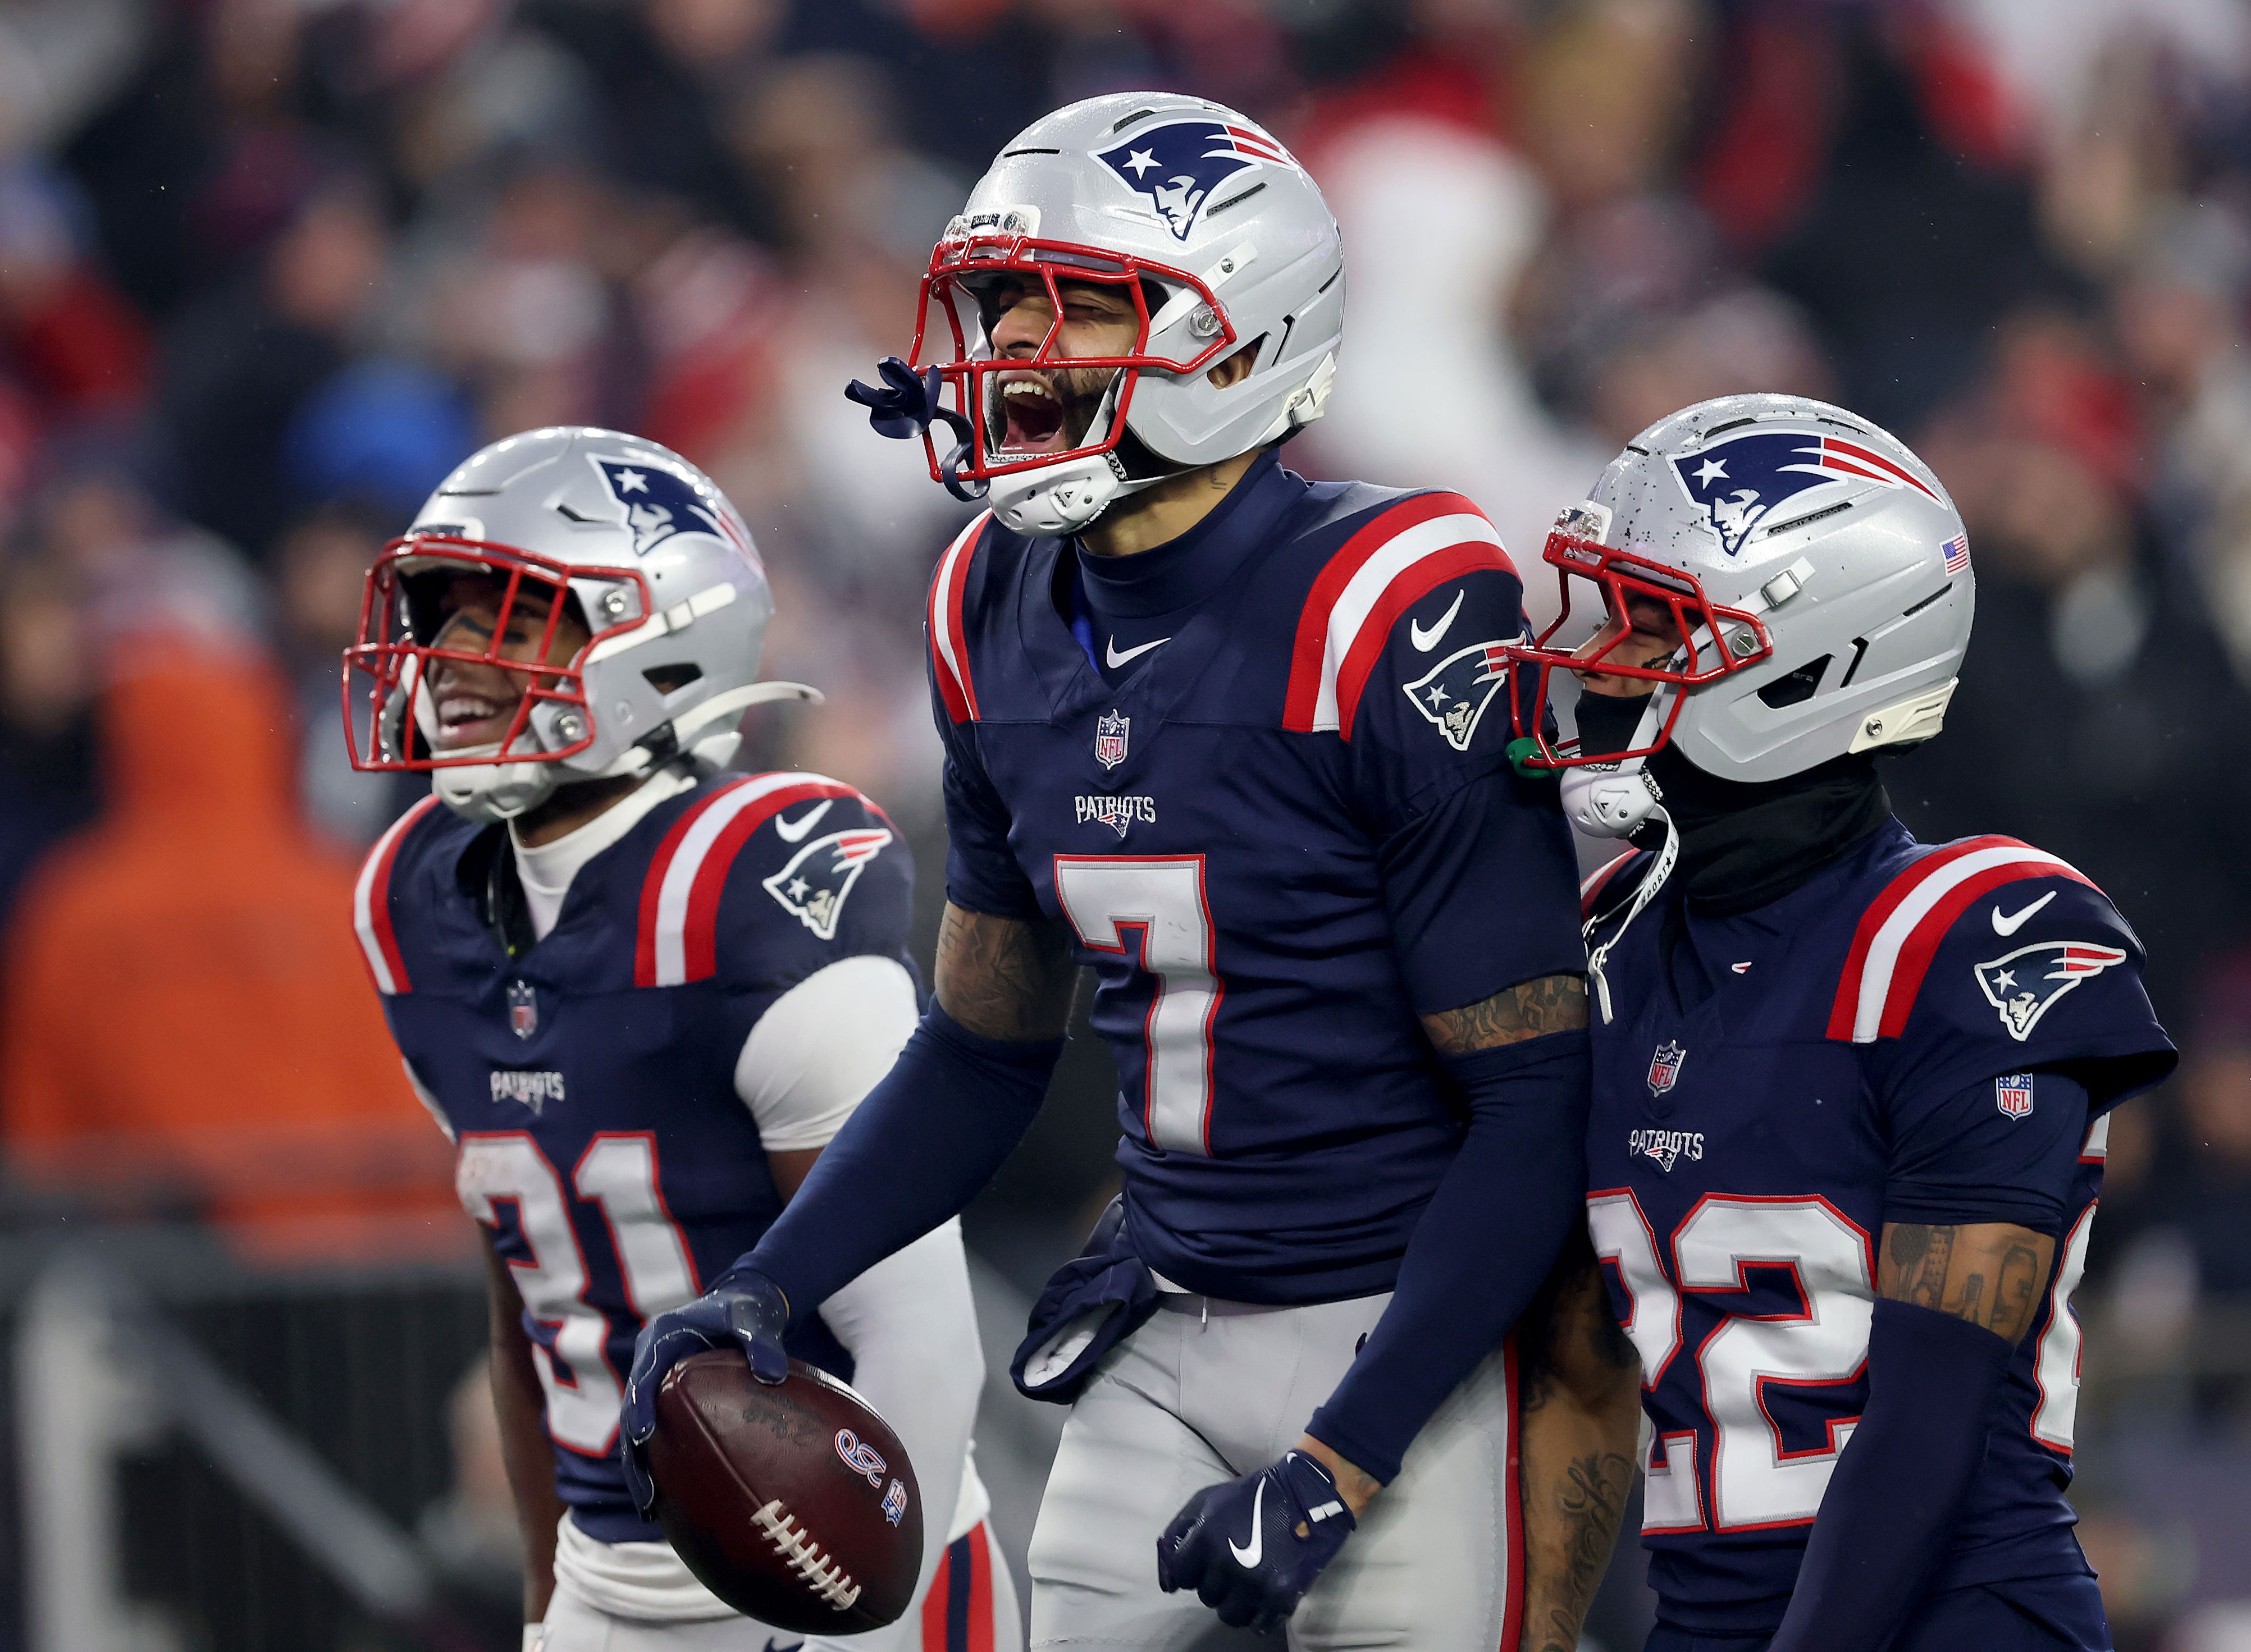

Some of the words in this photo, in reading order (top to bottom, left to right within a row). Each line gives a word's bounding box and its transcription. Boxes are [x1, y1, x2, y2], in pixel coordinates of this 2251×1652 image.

[1101, 738, 1122, 759] NFL
[1075, 795, 1157, 824] PATRIOTS
[1053, 853, 1226, 1158] 7
[1651, 1064, 1672, 1086] NFL
[2002, 1090, 2029, 1113] NFL
[1628, 1129, 1704, 1161] PATRIOTS
[455, 1130, 703, 1458] 31
[1586, 1187, 1878, 1535] 22
